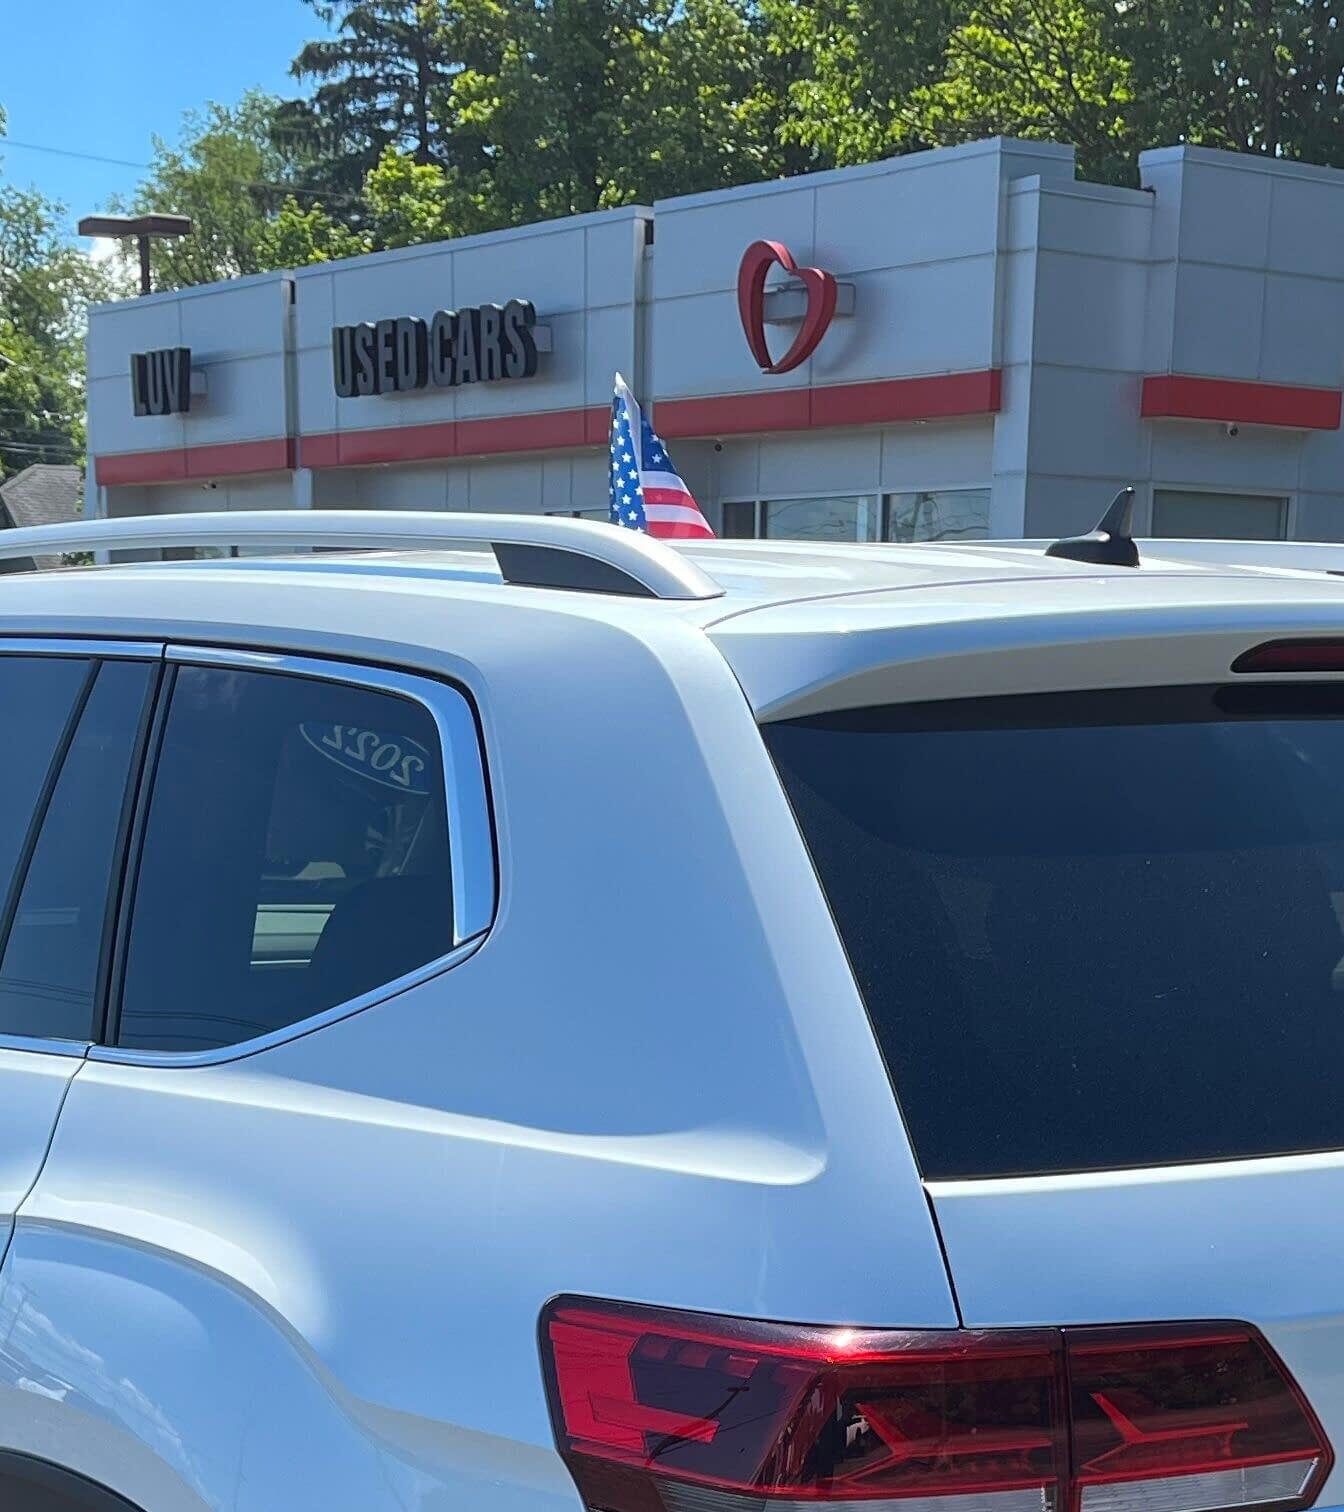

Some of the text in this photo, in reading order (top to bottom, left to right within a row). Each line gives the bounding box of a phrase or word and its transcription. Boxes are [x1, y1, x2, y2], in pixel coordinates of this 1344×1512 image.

[132, 299, 538, 416] LUV USED CARS
